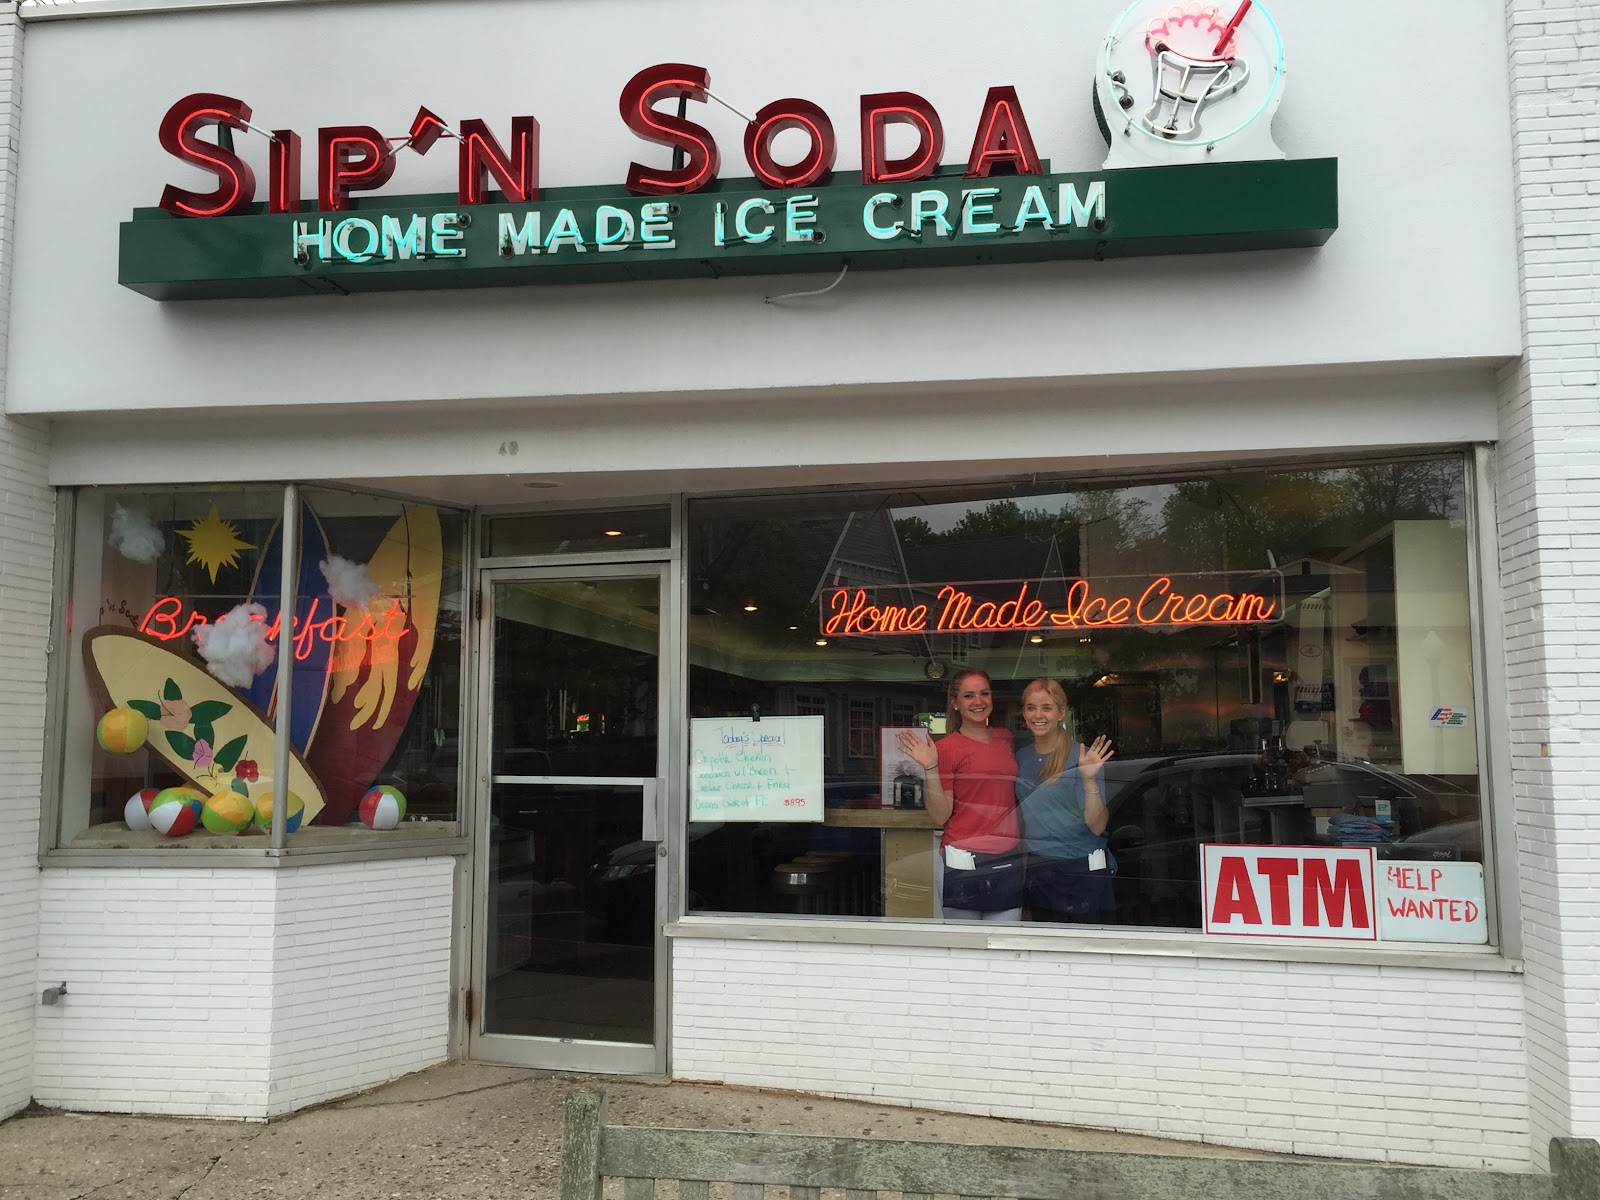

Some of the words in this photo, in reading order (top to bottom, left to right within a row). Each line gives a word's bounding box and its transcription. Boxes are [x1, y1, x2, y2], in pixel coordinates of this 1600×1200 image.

[159, 93, 540, 217] SIP'N
[619, 63, 1043, 195] SODA
[292, 213, 467, 263] HOME
[499, 202, 677, 256] MADE
[714, 195, 819, 246] ICE
[863, 181, 1107, 240] CREAM
[140, 596, 410, 660] Brfast
[825, 587, 928, 633] Home
[936, 582, 1048, 630] Made
[1050, 579, 1129, 628] Ice
[1136, 576, 1277, 623] Cream
[713, 726, 750, 756] Today's
[1211, 856, 1370, 929] ATM
[1387, 866, 1443, 892] HELP
[1387, 897, 1479, 923] WANTED
